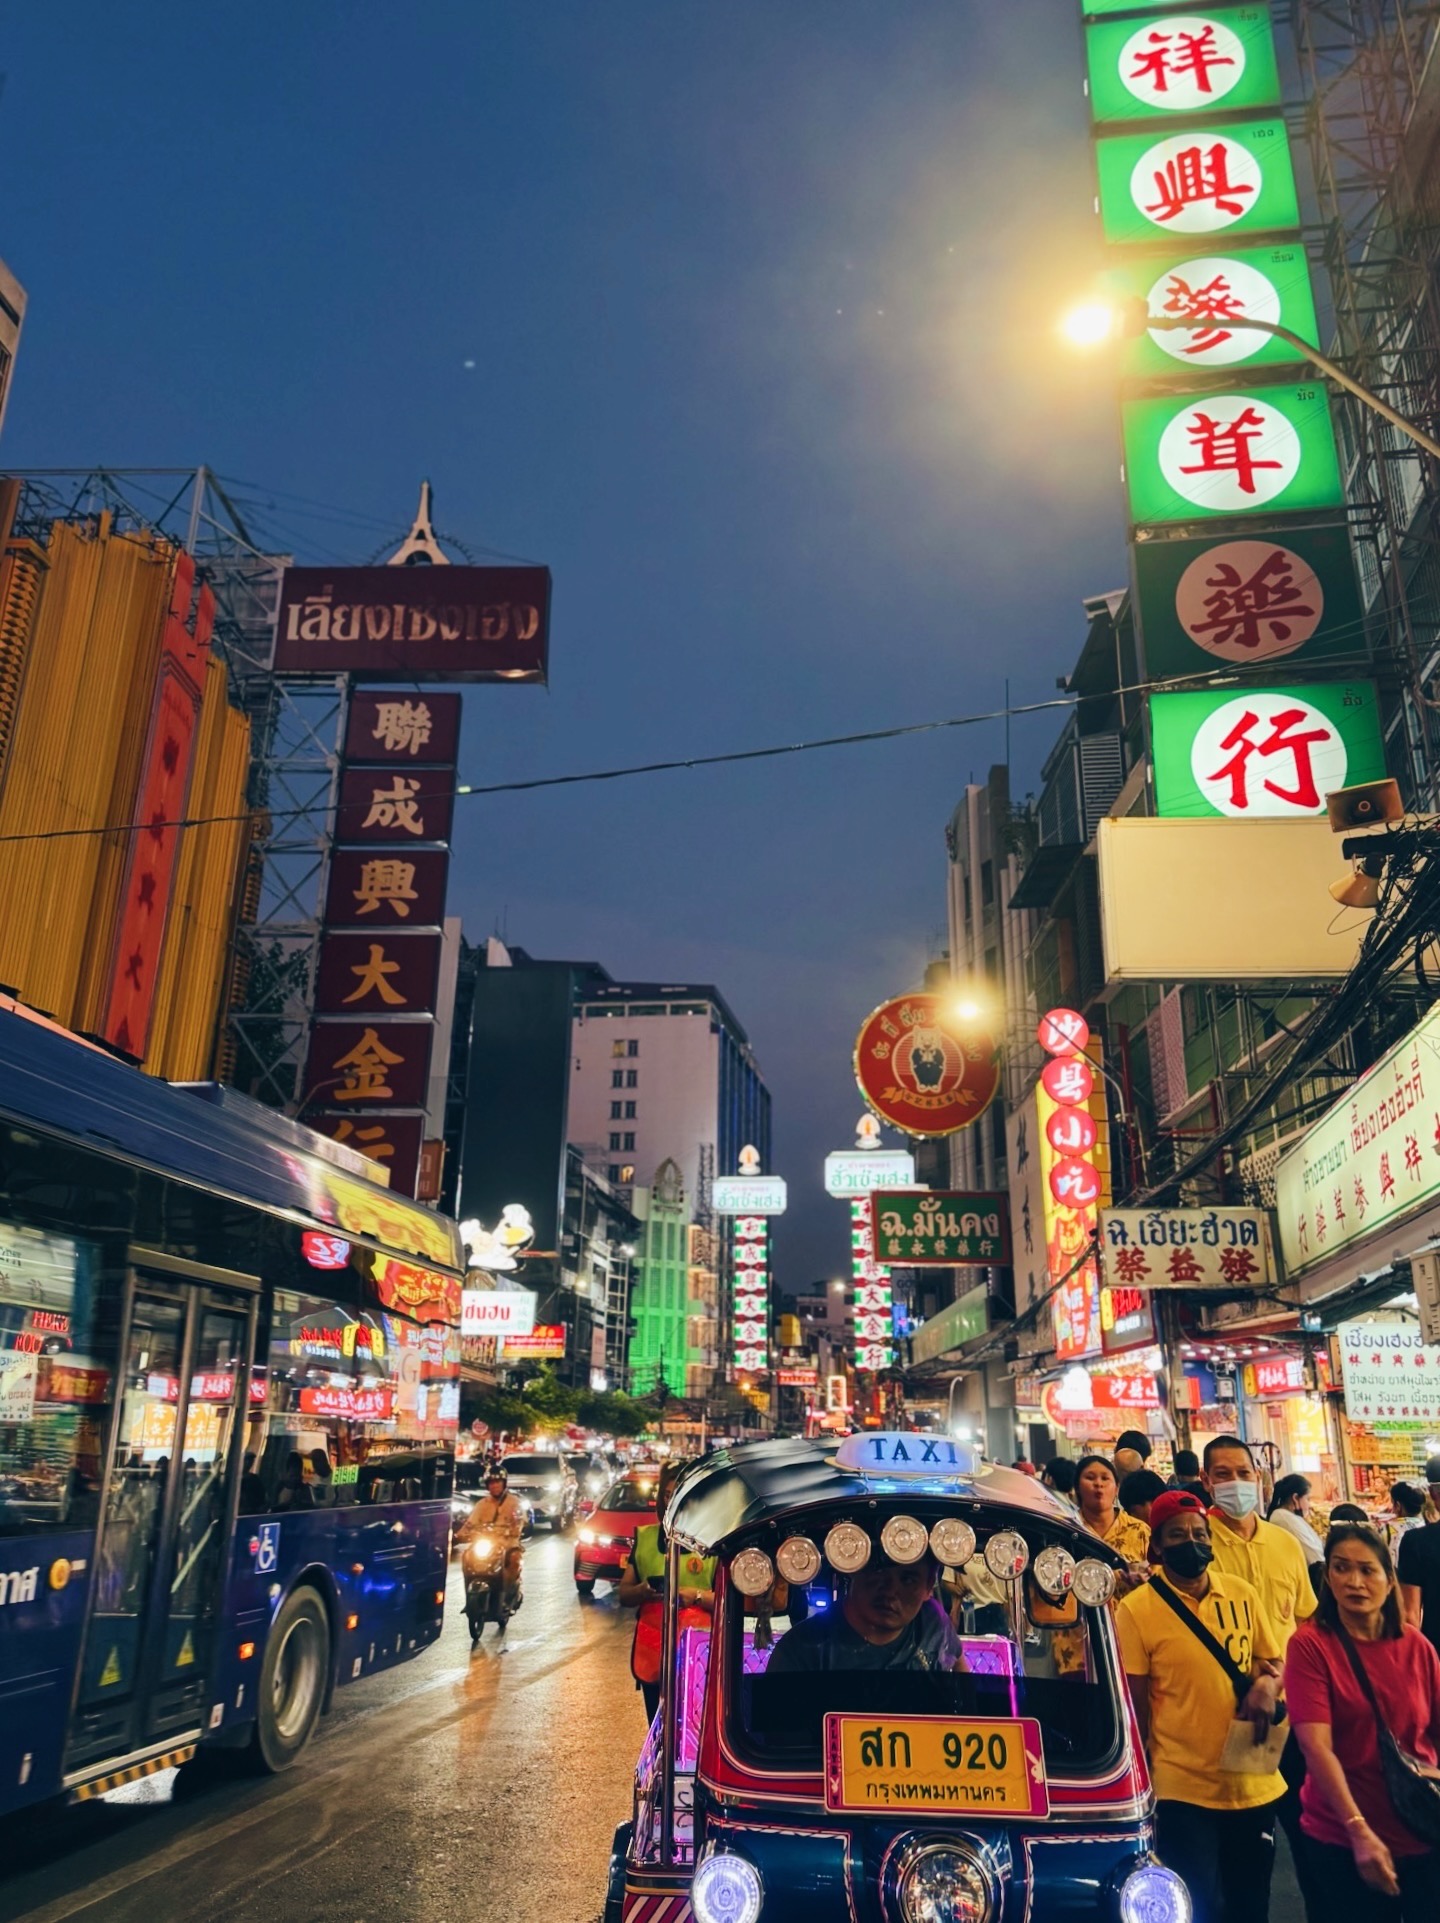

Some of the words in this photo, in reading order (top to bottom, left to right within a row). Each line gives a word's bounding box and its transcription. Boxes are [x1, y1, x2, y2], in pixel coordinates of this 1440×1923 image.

[881, 1197, 1000, 1237] ฉ.มั่นคง
[1113, 1247, 1261, 1283] 蔡益發
[869, 1438, 958, 1464] TAXI
[860, 1727, 911, 1768] สก
[943, 1732, 1007, 1771] 920
[866, 1782, 1006, 1804] กรุงเทพมหานคร
